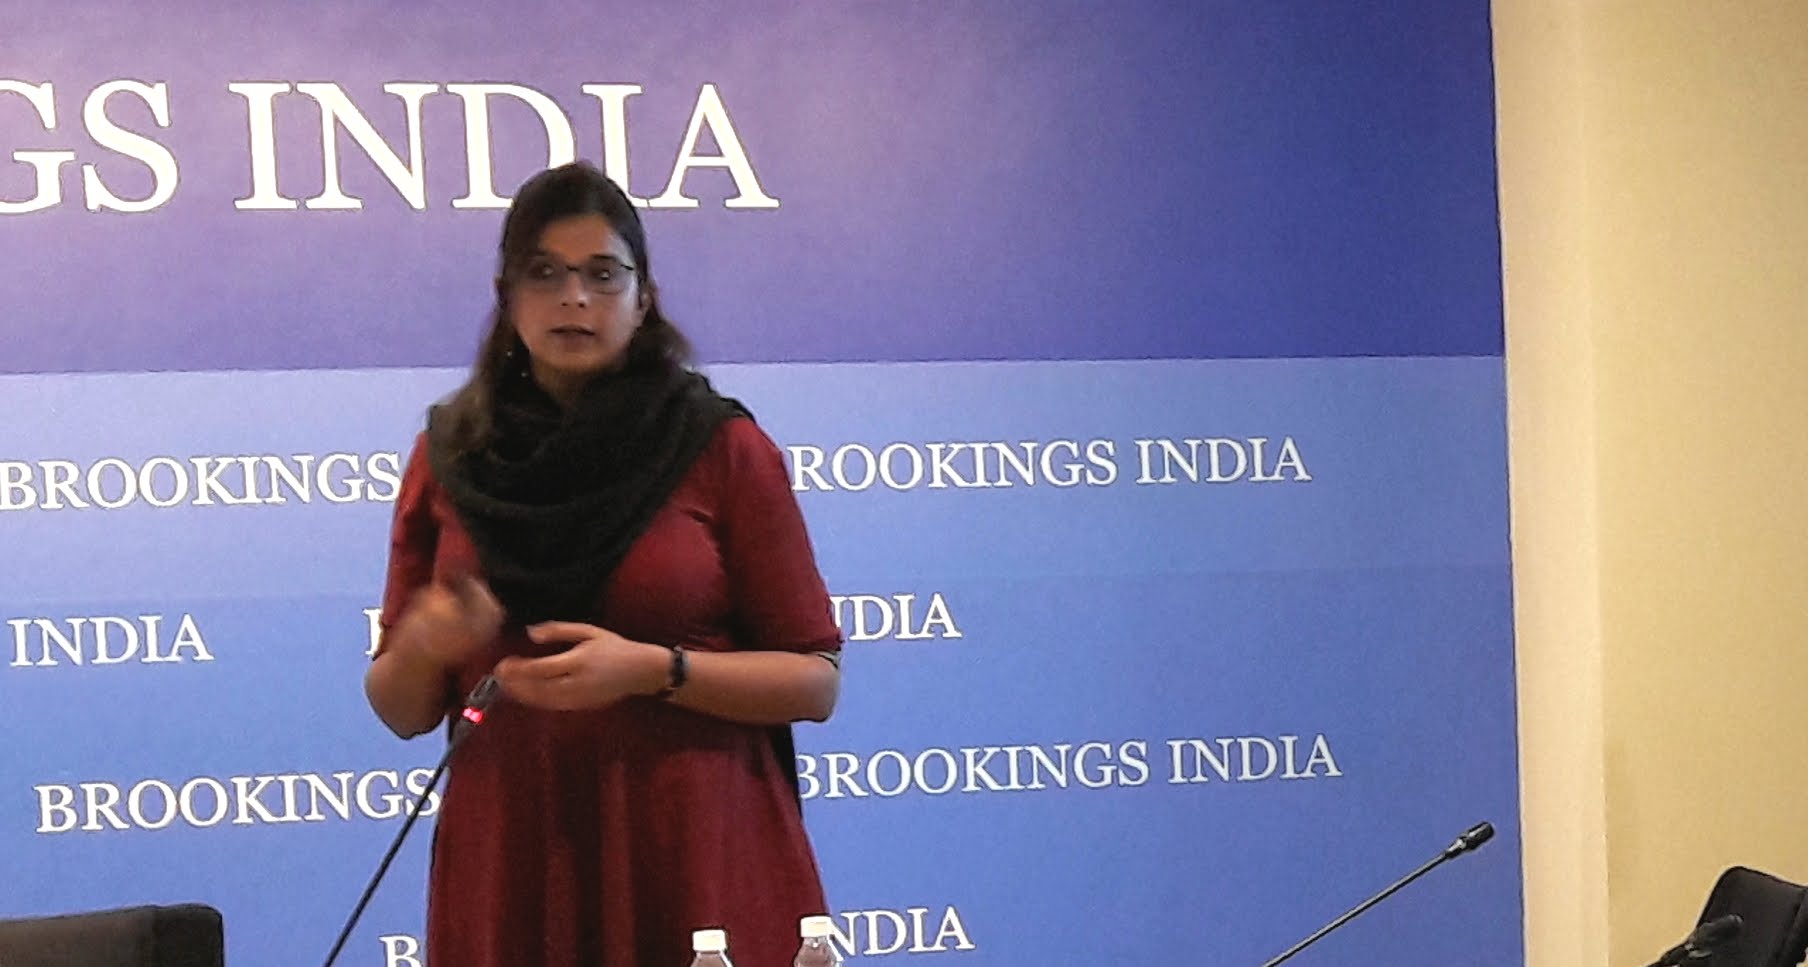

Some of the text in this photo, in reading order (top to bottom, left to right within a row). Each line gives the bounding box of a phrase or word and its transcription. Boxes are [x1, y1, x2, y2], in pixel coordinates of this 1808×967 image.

[229, 83, 780, 210] INDIA
[0, 452, 401, 511] BROOKINGS
[787, 438, 1311, 491] ROOKINGS INDIA
[7, 613, 214, 667] INDIA
[797, 735, 1341, 799] BROOKINGS INDIA
[34, 768, 440, 833] BROOKINGS
[833, 907, 975, 956] NDIA
